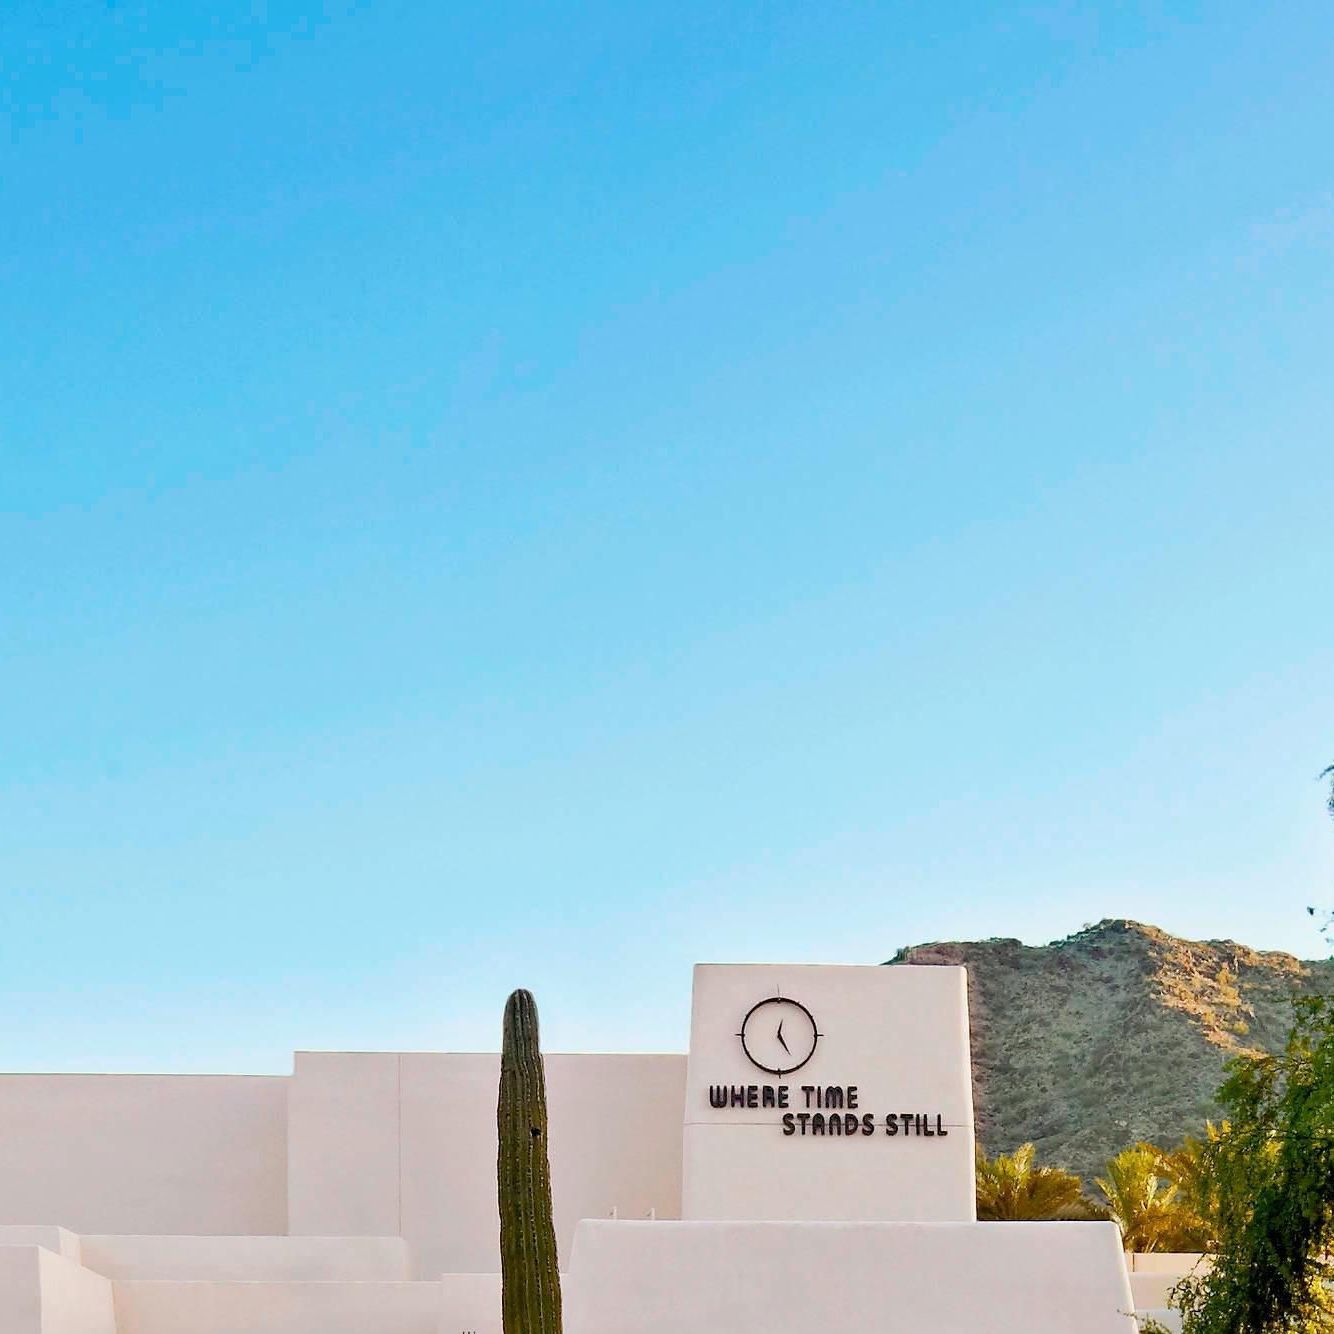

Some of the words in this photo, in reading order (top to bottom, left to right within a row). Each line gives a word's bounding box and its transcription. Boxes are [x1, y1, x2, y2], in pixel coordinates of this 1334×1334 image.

[709, 1084, 789, 1109] WHERE
[801, 1085, 859, 1109] TIME
[782, 1112, 875, 1136] STANDS
[885, 1113, 948, 1136] STILL
